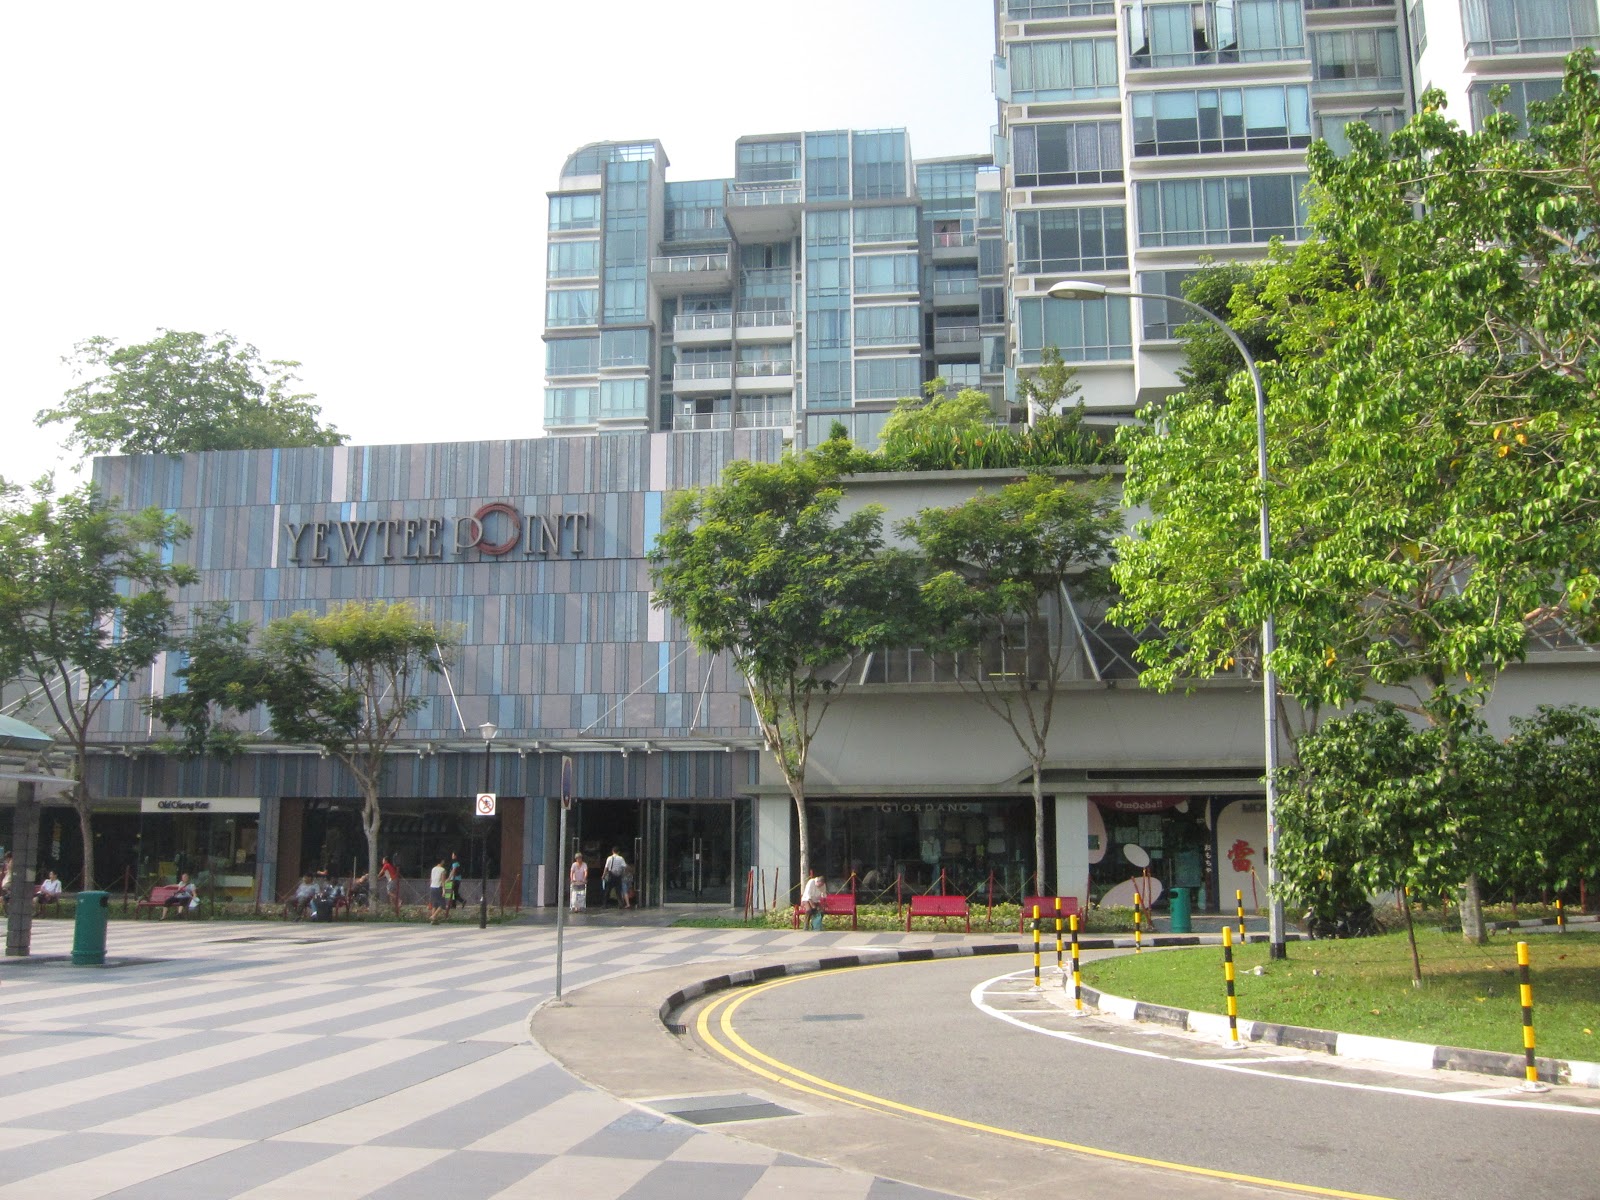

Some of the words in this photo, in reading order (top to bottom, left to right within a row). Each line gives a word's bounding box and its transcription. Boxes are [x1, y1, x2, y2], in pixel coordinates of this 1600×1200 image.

[451, 502, 589, 557] POINT
[158, 800, 171, 809] Old
[881, 802, 970, 813] GIORDANO
